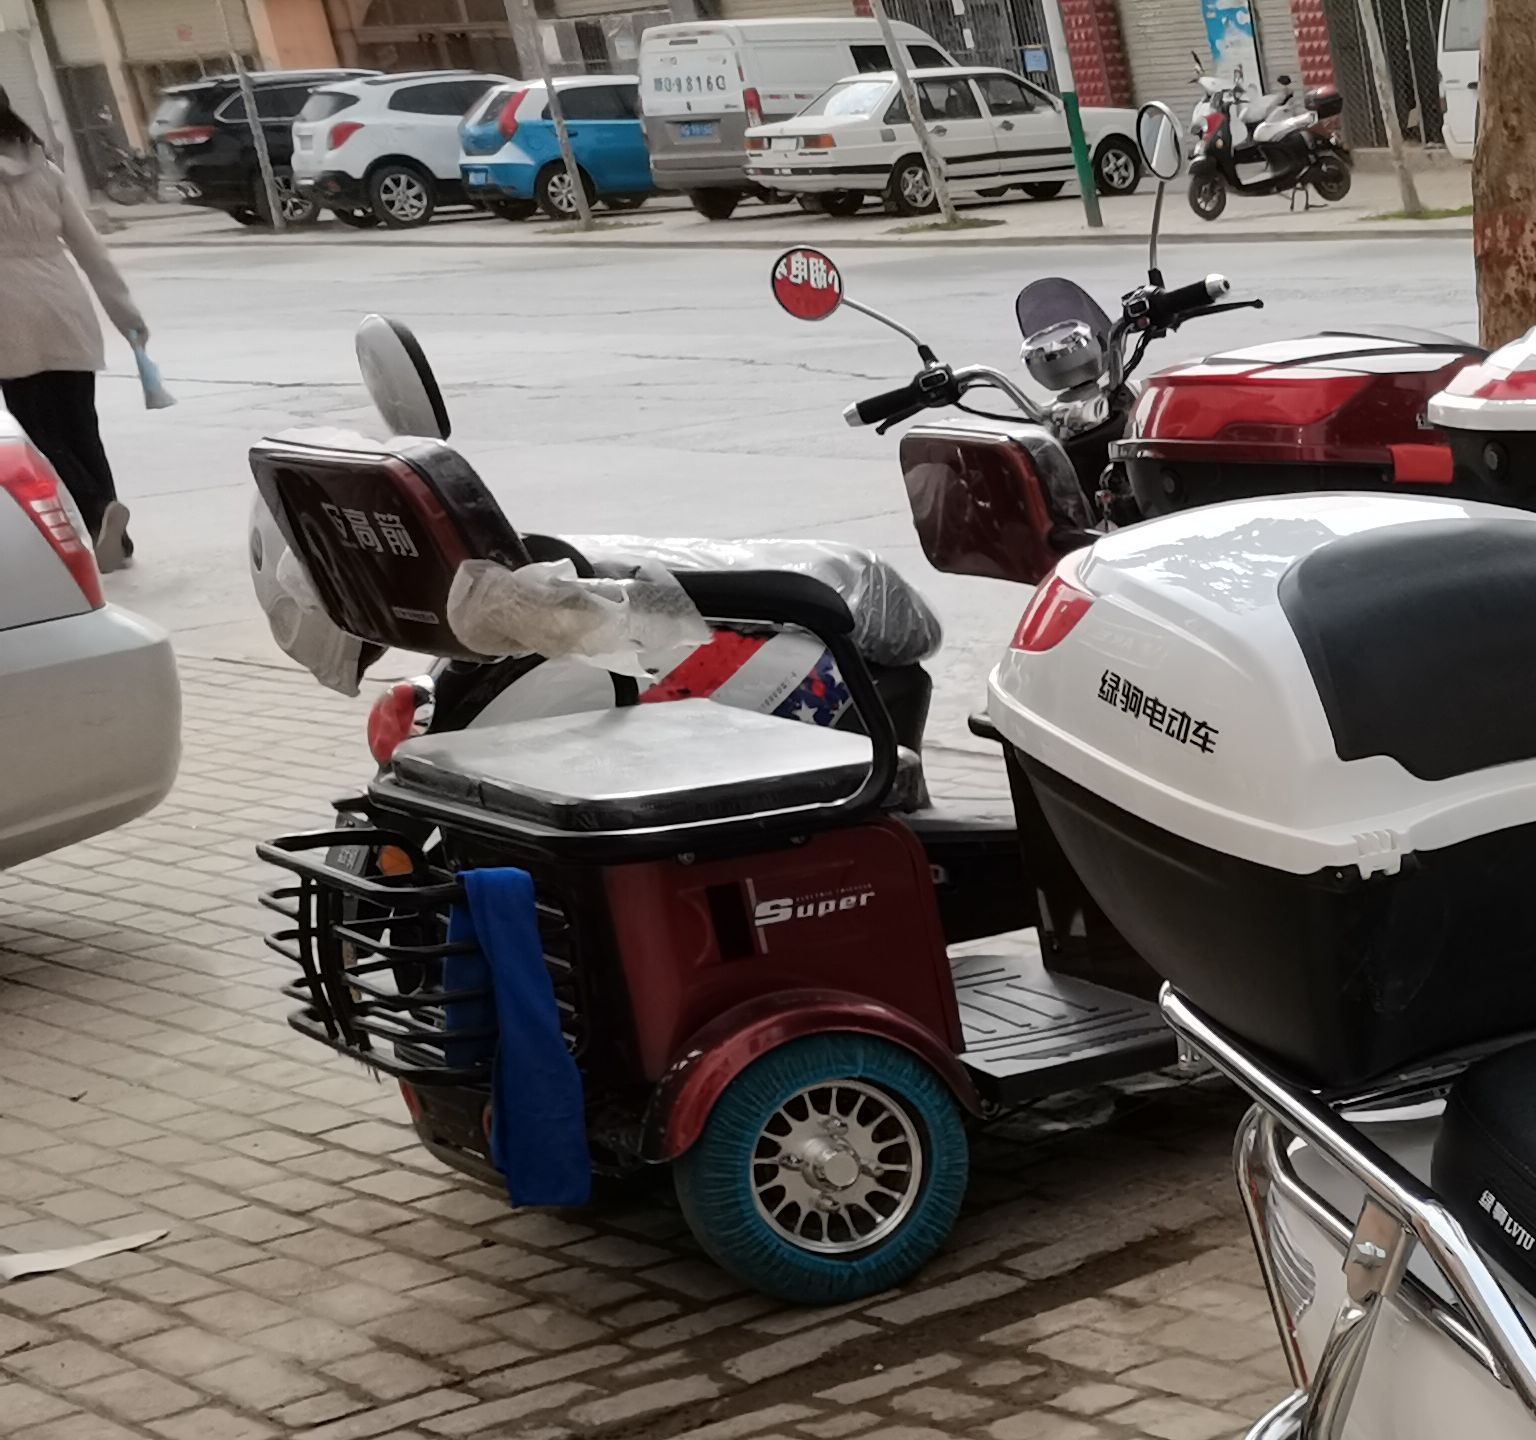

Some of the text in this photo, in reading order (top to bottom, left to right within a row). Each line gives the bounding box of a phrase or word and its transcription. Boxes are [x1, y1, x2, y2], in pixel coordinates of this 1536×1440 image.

[1098, 669, 1219, 753] 绿驹电动车
[754, 891, 876, 927] Super
